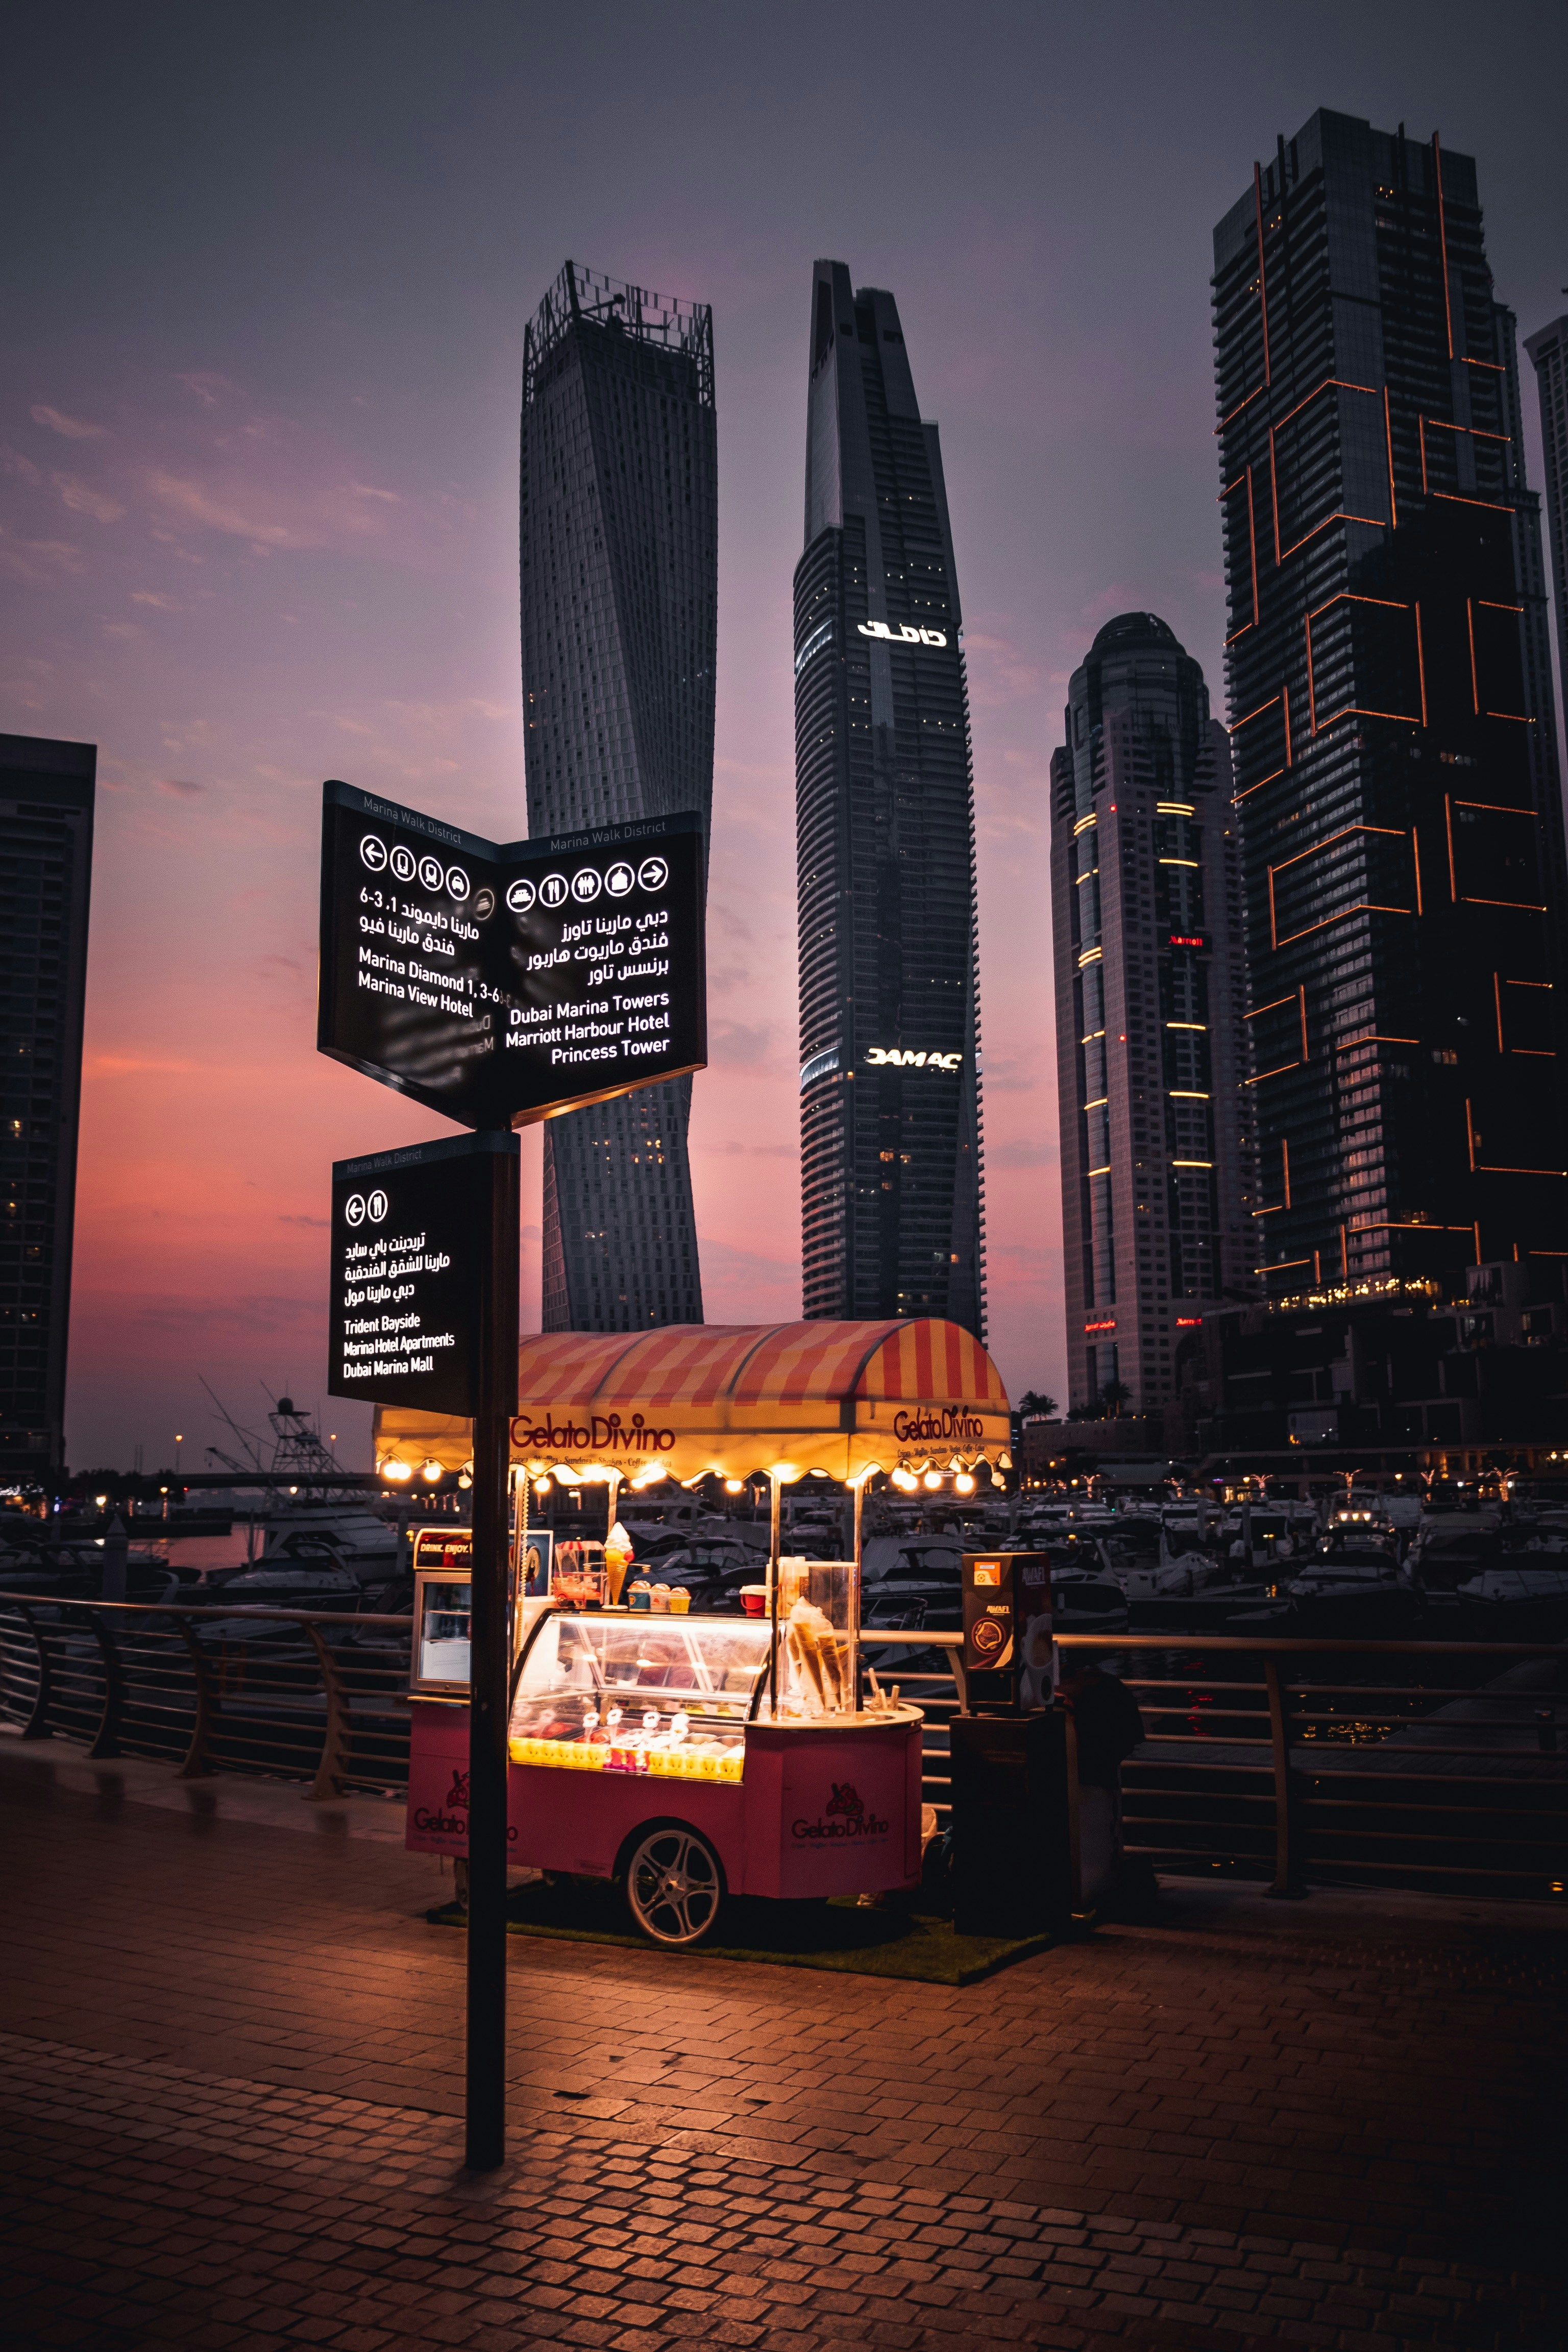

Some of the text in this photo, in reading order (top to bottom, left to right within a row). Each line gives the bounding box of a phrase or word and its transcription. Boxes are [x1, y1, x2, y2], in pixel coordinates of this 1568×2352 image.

[364, 796, 461, 844] Marina Walk District
[551, 821, 666, 851] Marina Walk District
[401, 903, 448, 929] دايموند
[451, 916, 479, 940] مارينا
[561, 911, 668, 943] دبي مارينا تاورز
[359, 916, 455, 956] فندق مارينا فيو
[1168, 935, 1203, 946] Marriott
[527, 932, 669, 971] فندق ماريوت هاربور
[359, 946, 405, 975] Marina
[409, 961, 464, 992] Diamond
[480, 983, 500, 1002] 3-6
[587, 958, 669, 986] برنسس تاور
[358, 970, 474, 1018] Marina View Hotel
[510, 1005, 552, 1025] Dubai
[557, 1000, 608, 1019] Marina
[612, 993, 670, 1011] Towers
[506, 1027, 561, 1048] Marriott
[565, 1022, 624, 1041] Harbour
[628, 1012, 670, 1033] Hotel
[552, 1039, 670, 1065] Princess Tower
[866, 1047, 963, 1069] DAMAC
[347, 1149, 422, 1173] Marina Walk District
[345, 1232, 426, 1261] تريدينت باي سايد
[345, 1252, 450, 1283] مارينا للشقق الفندقية
[345, 1284, 415, 1307] دبي مارينا مول
[344, 1312, 421, 1335] Trident Bayside
[344, 1332, 455, 1357] Marina Hotel Apartments
[343, 1356, 434, 1378] Dubai Marina Mall
[627, 1457, 647, 1469] Coffee
